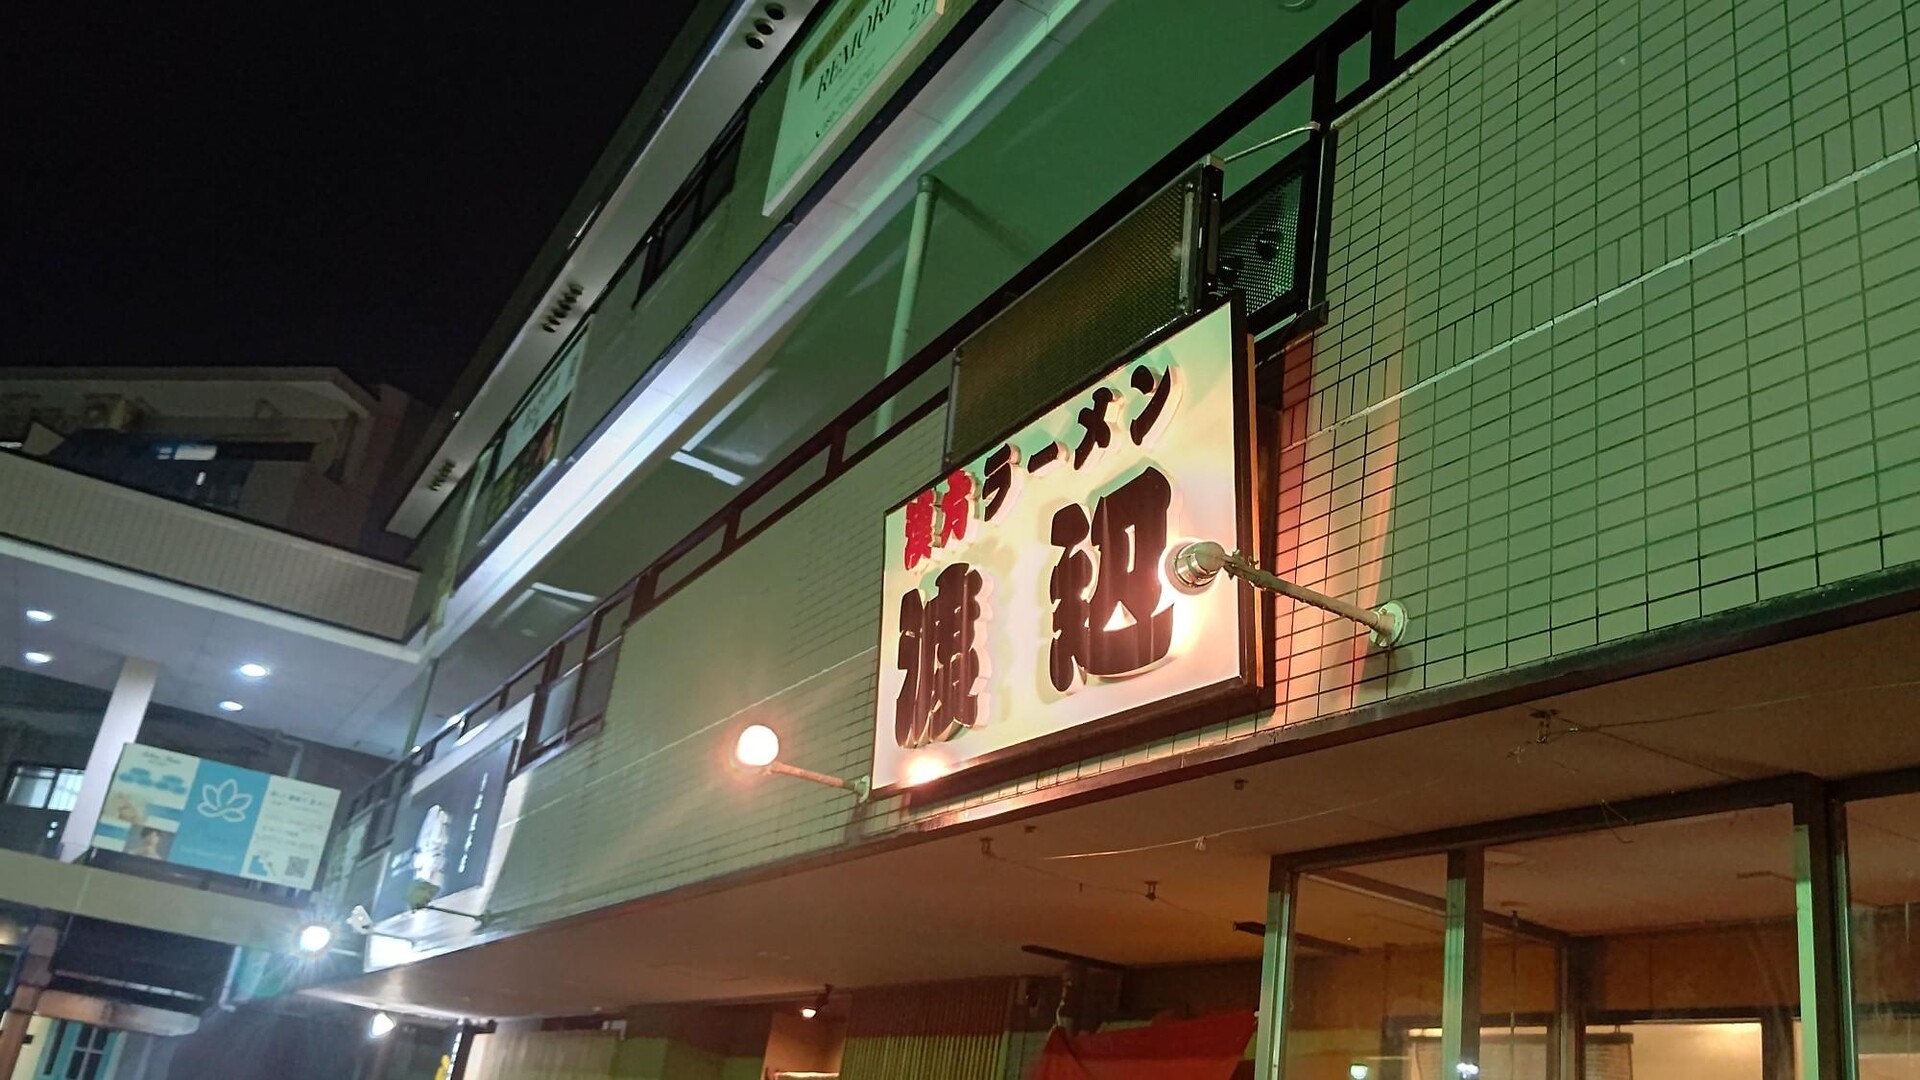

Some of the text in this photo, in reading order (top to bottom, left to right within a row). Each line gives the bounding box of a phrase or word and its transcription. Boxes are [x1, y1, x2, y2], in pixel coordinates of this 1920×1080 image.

[904, 364, 1171, 571] 漢方ラーメン
